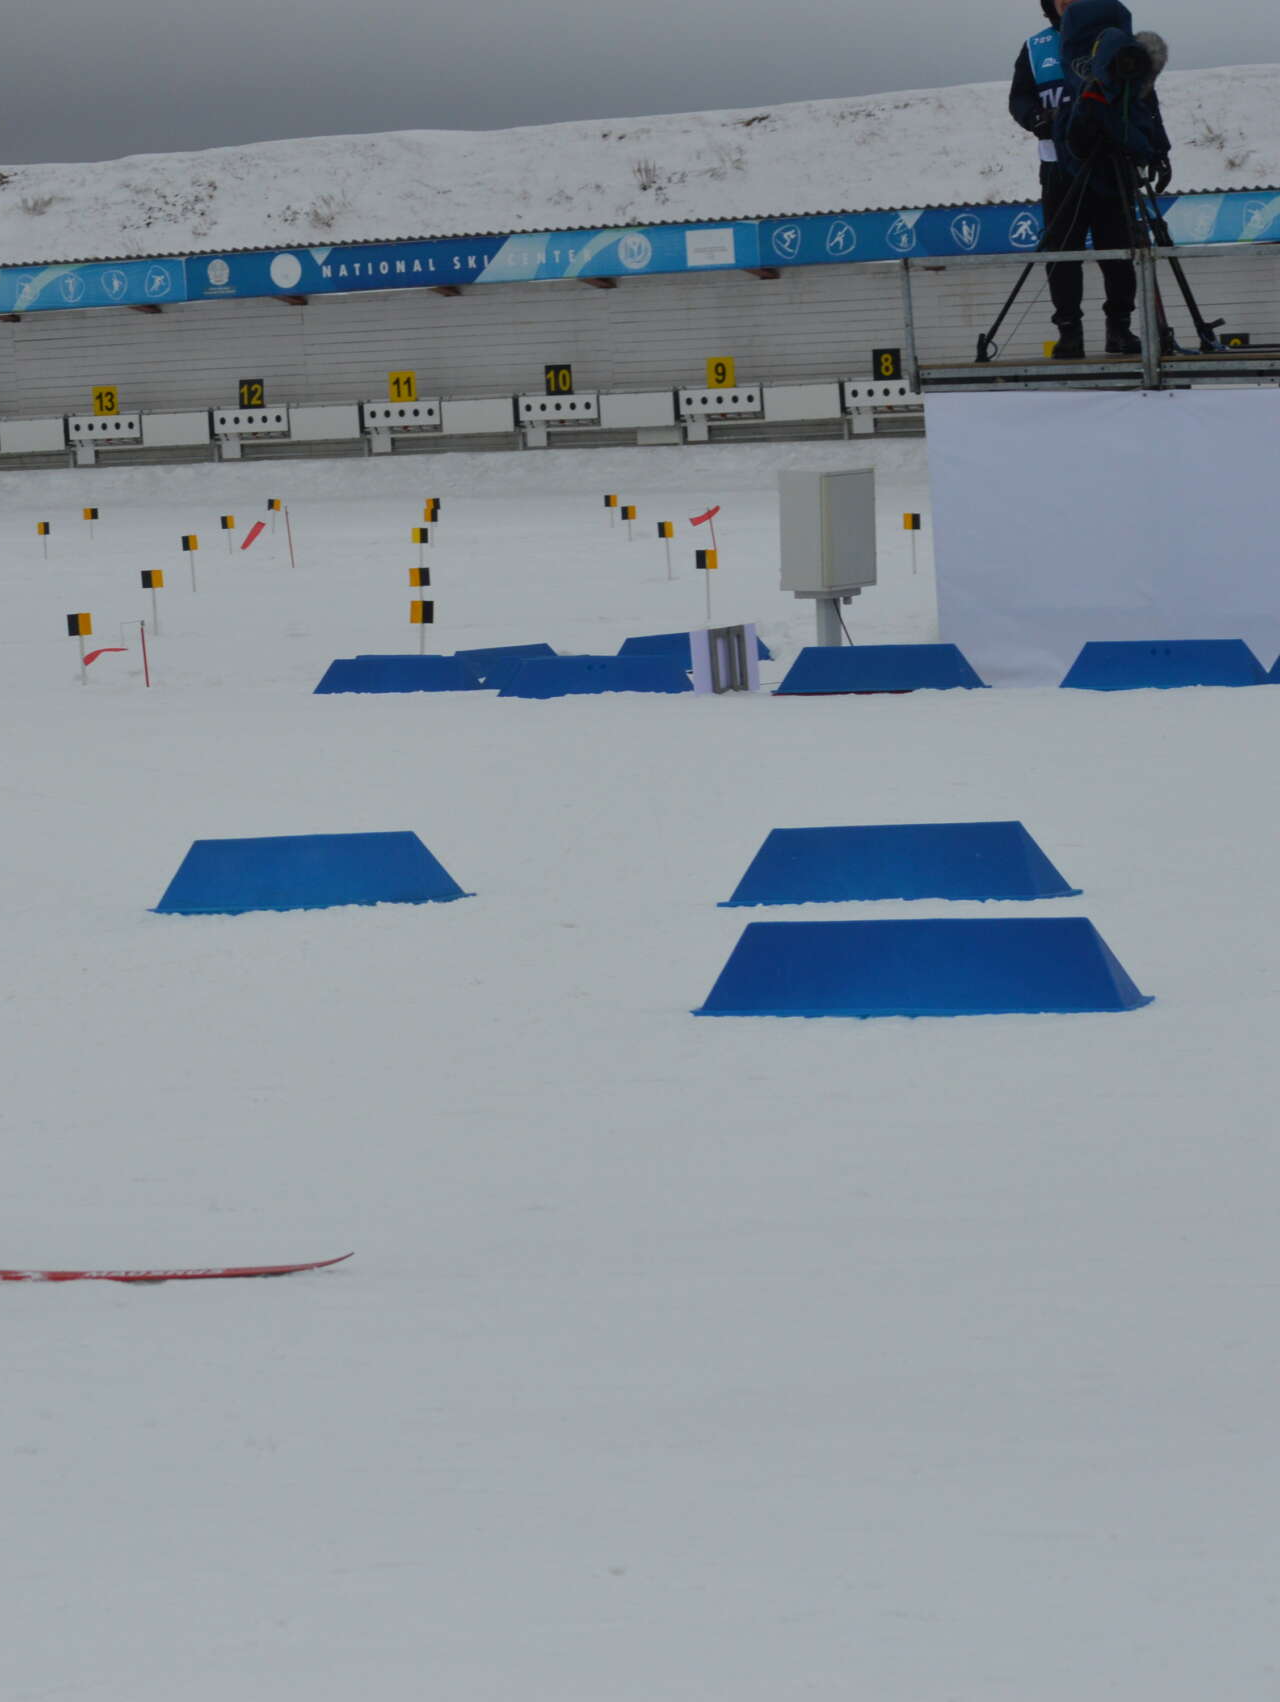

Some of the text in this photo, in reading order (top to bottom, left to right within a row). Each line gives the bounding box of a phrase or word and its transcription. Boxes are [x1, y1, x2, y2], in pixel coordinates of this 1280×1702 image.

[322, 248, 593, 278] NATIONAL SKI CENTER
[714, 362, 727, 385] 9
[880, 354, 894, 377] 8
[392, 376, 412, 397] 11
[546, 369, 570, 391] 10
[95, 391, 116, 411] 13
[239, 384, 262, 405] 12
